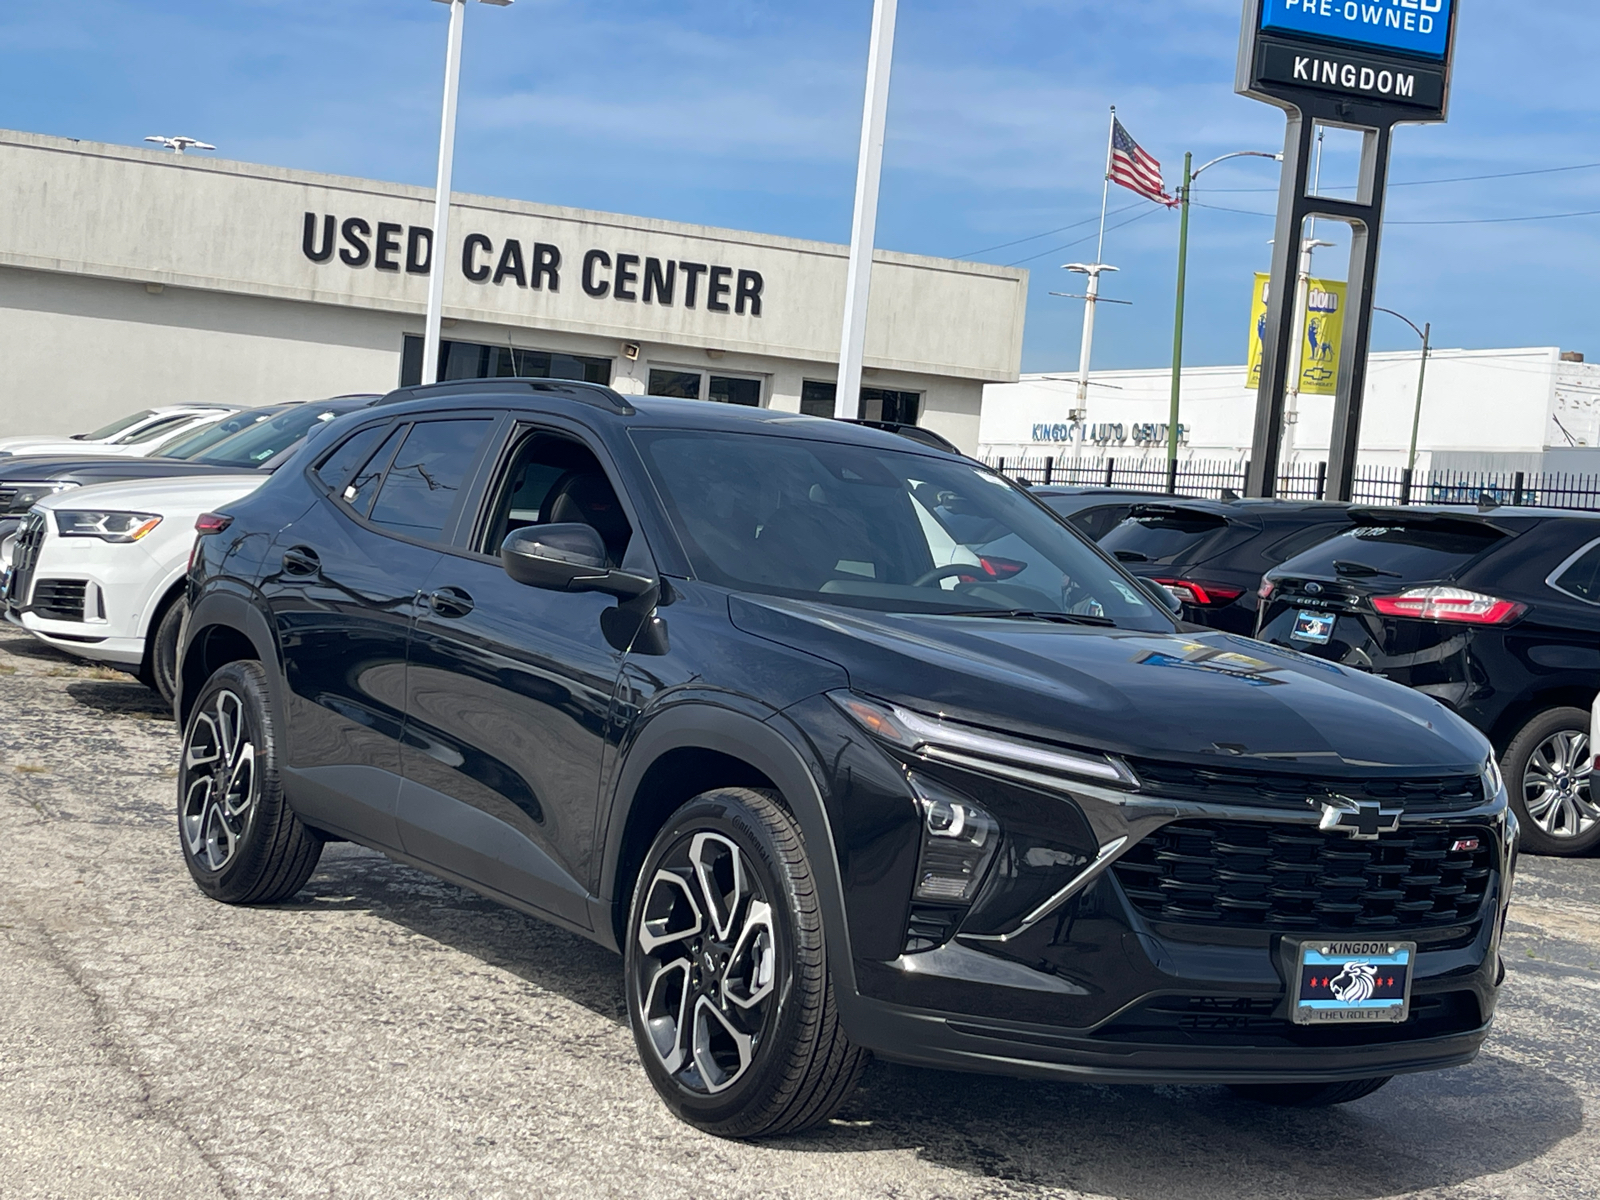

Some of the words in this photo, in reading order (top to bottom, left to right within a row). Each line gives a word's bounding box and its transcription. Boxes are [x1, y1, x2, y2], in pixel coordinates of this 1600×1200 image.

[1293, 56, 1415, 97] KINGDOM
[302, 212, 434, 277] USED
[462, 232, 561, 291] CAR
[581, 248, 764, 315] CENTER
[1132, 422, 1188, 441] CENTR
[1328, 942, 1389, 955] KINGDOM
[1319, 1010, 1380, 1020] CHEVROLET
